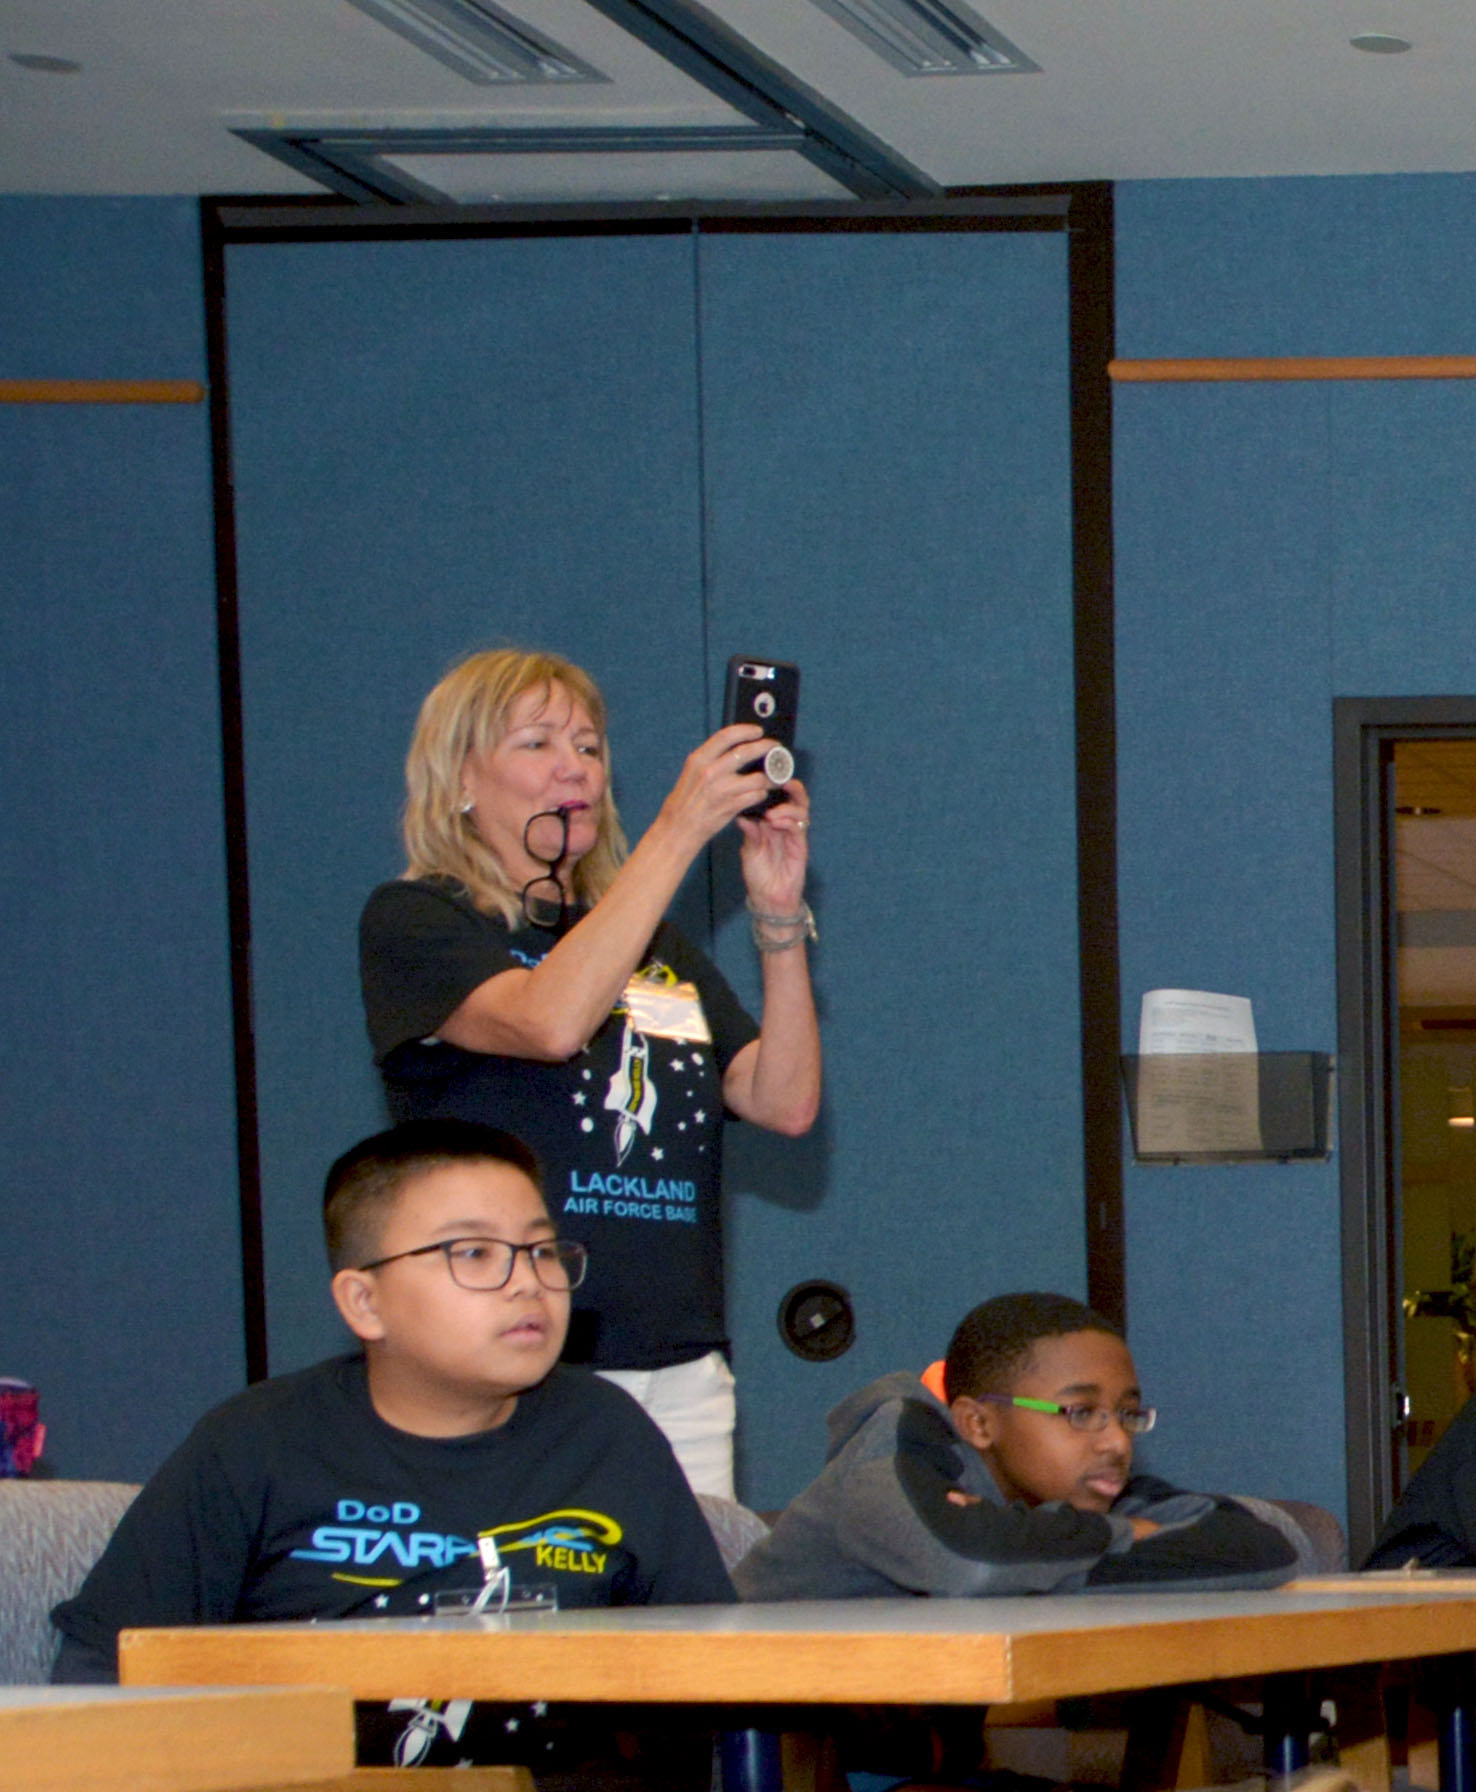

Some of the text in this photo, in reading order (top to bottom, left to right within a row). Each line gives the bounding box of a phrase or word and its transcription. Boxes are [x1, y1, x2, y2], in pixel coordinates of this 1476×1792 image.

[570, 1169, 697, 1202] LACKLAND
[563, 1196, 600, 1215] AIR
[603, 1199, 663, 1220] FORCE
[337, 1499, 421, 1526] DoD
[536, 1545, 607, 1574] KELLY
